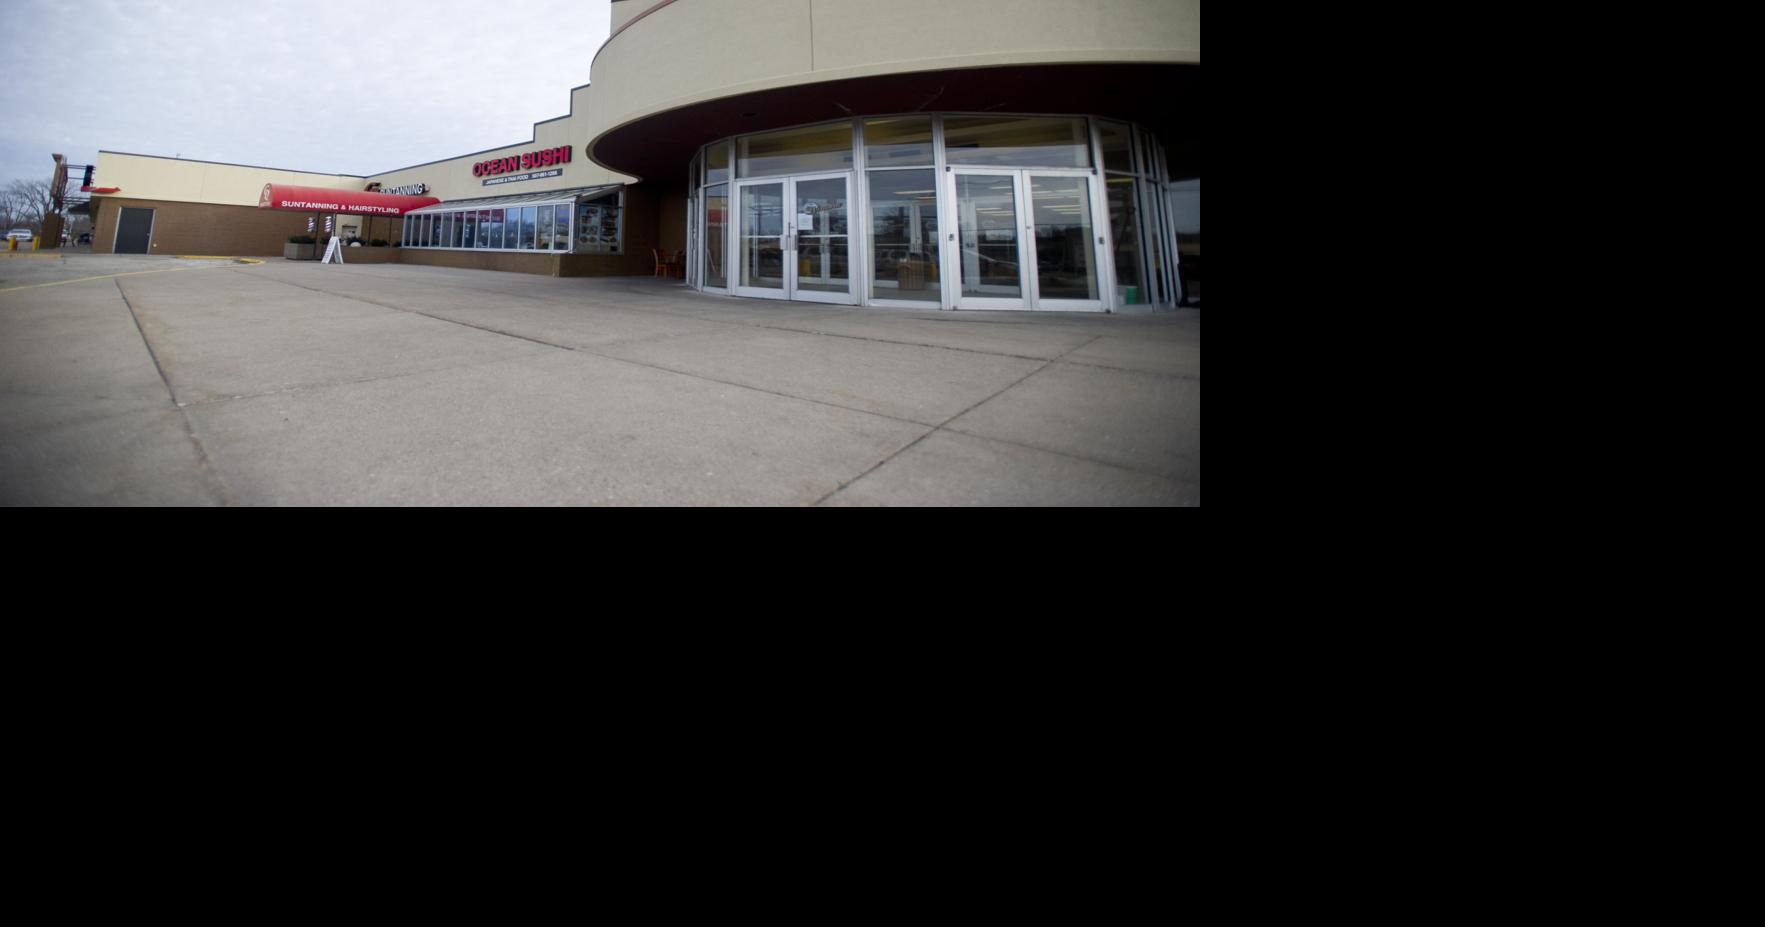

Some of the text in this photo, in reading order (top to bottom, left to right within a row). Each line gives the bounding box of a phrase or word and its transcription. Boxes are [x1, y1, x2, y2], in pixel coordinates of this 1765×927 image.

[473, 145, 571, 177] OCEAN SUSHI
[281, 200, 338, 210] SUNTANNING
[348, 204, 400, 214] HAIRSTYLING
